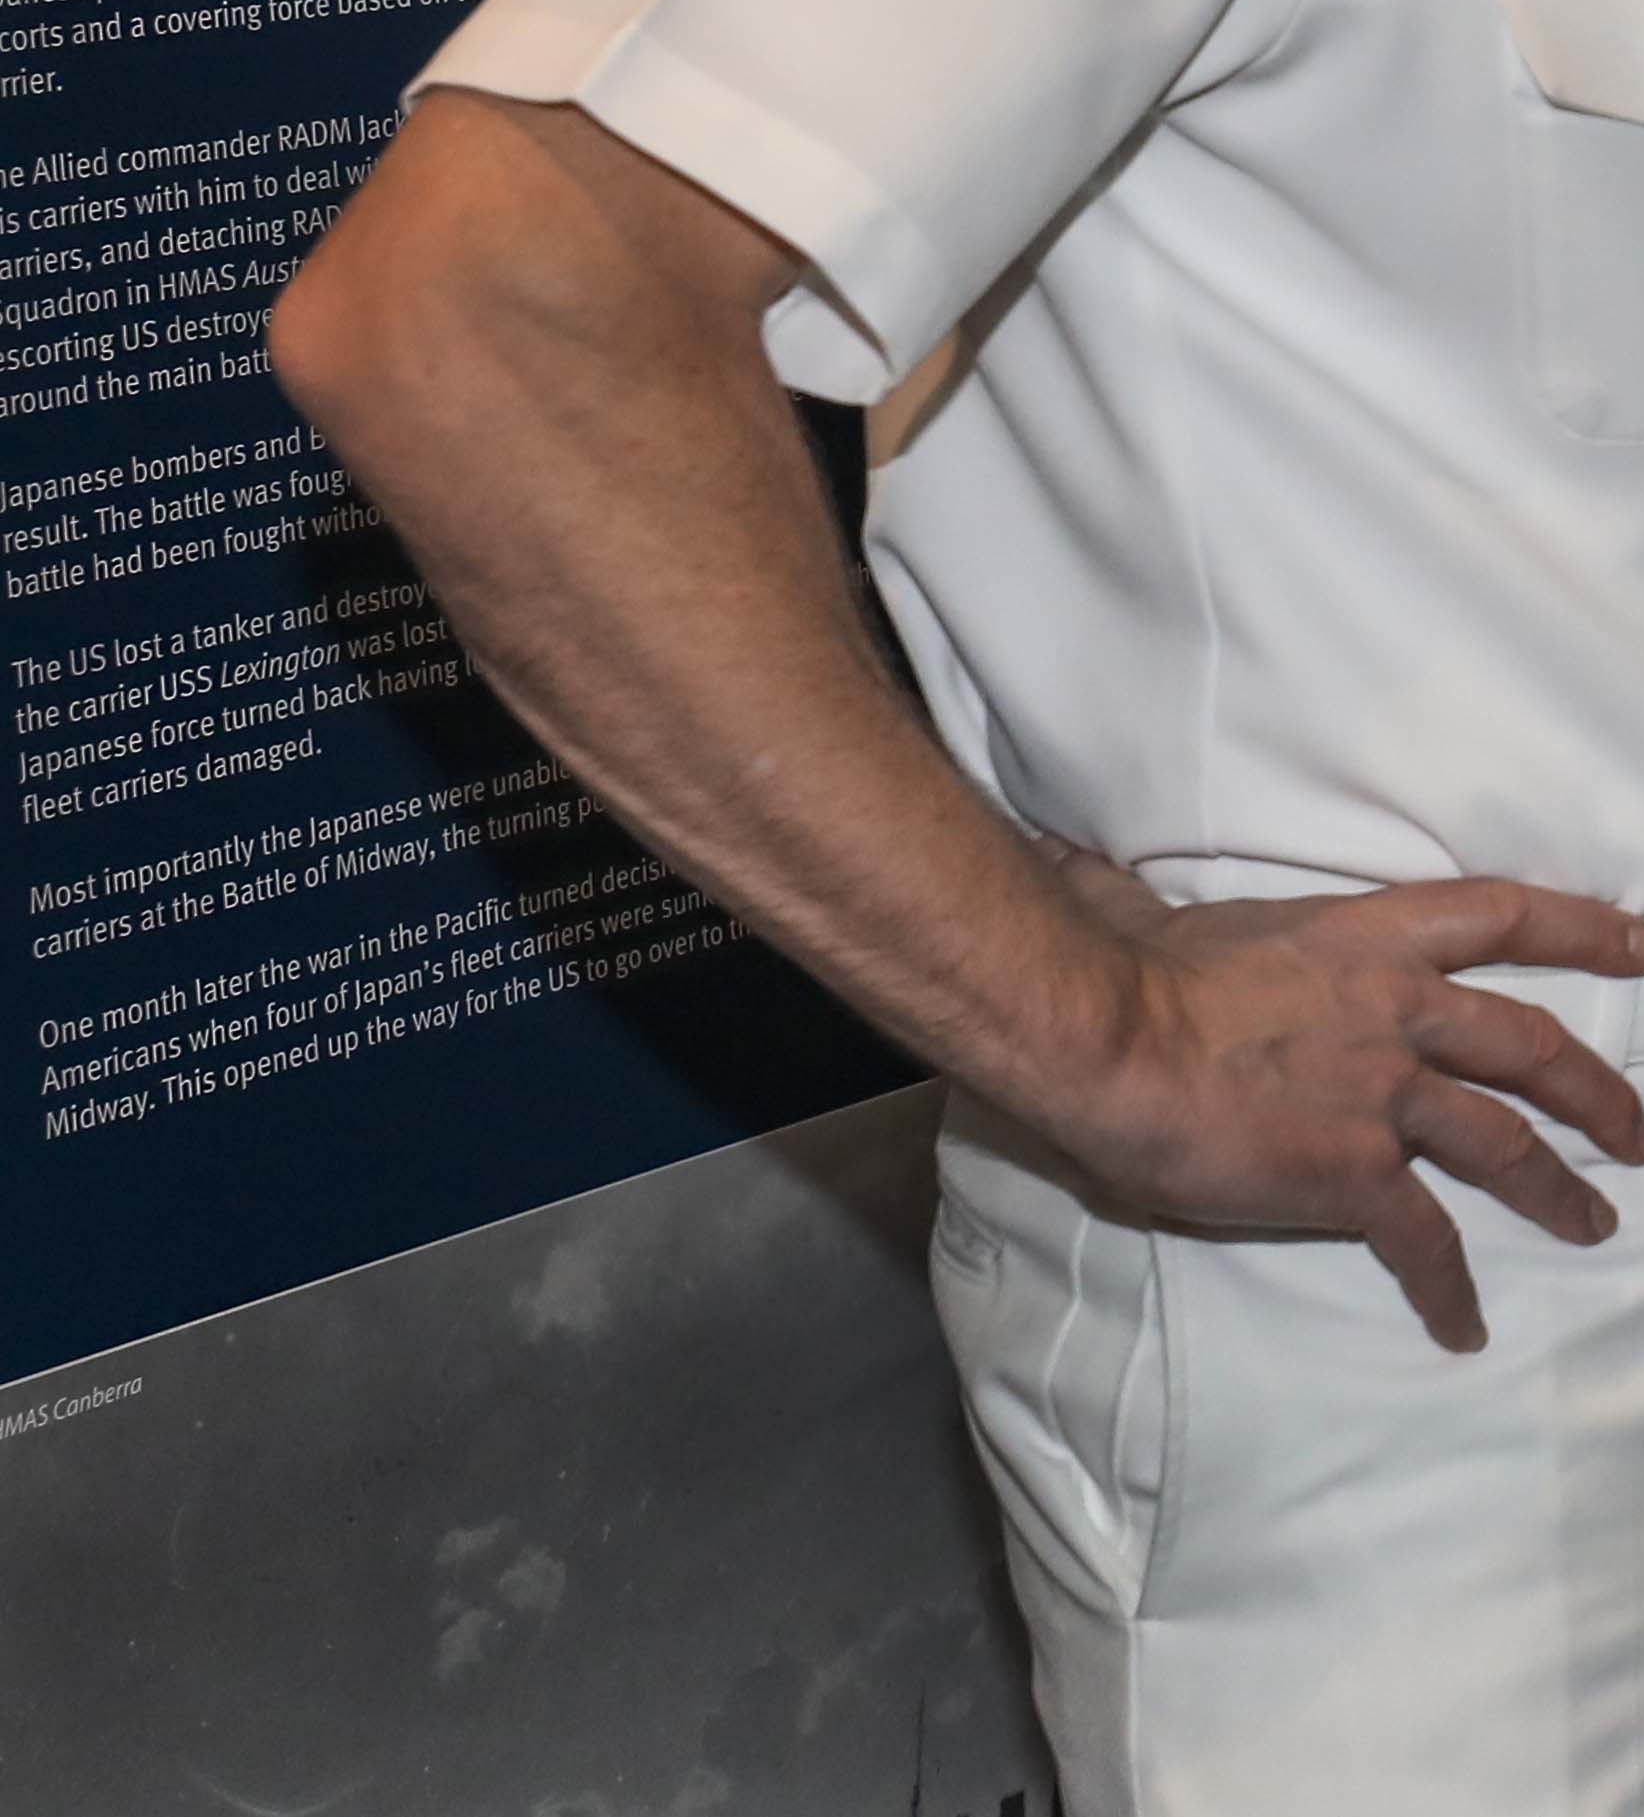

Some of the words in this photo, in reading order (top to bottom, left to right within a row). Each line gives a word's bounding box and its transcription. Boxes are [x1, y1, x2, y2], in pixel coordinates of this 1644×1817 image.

[16, 703, 59, 734] the
[69, 683, 152, 722] carrier
[161, 665, 212, 701] USS
[221, 643, 339, 688] Lexington
[348, 631, 395, 660] was
[402, 619, 448, 648] lost
[42, 1036, 181, 1095] Americans
[189, 1015, 257, 1052] when
[267, 998, 317, 1030] four
[324, 981, 348, 1014] of
[355, 960, 444, 1010] Japan's
[451, 942, 503, 978] fleet
[511, 920, 594, 961] carriers
[601, 904, 654, 935] were
[47, 1091, 155, 1140] Midway.
[162, 1068, 215, 1104] This
[224, 1033, 318, 1090] opened
[329, 1031, 358, 1059] up
[366, 1016, 405, 1046] the
[412, 1001, 459, 1032] way
[466, 988, 497, 1016] for
[504, 976, 541, 1006] the
[549, 960, 580, 992] US
[587, 959, 608, 982] to
[616, 949, 641, 979] go
[649, 933, 696, 963] over
[702, 925, 722, 949] to
[53, 1377, 142, 1420] Canberra
